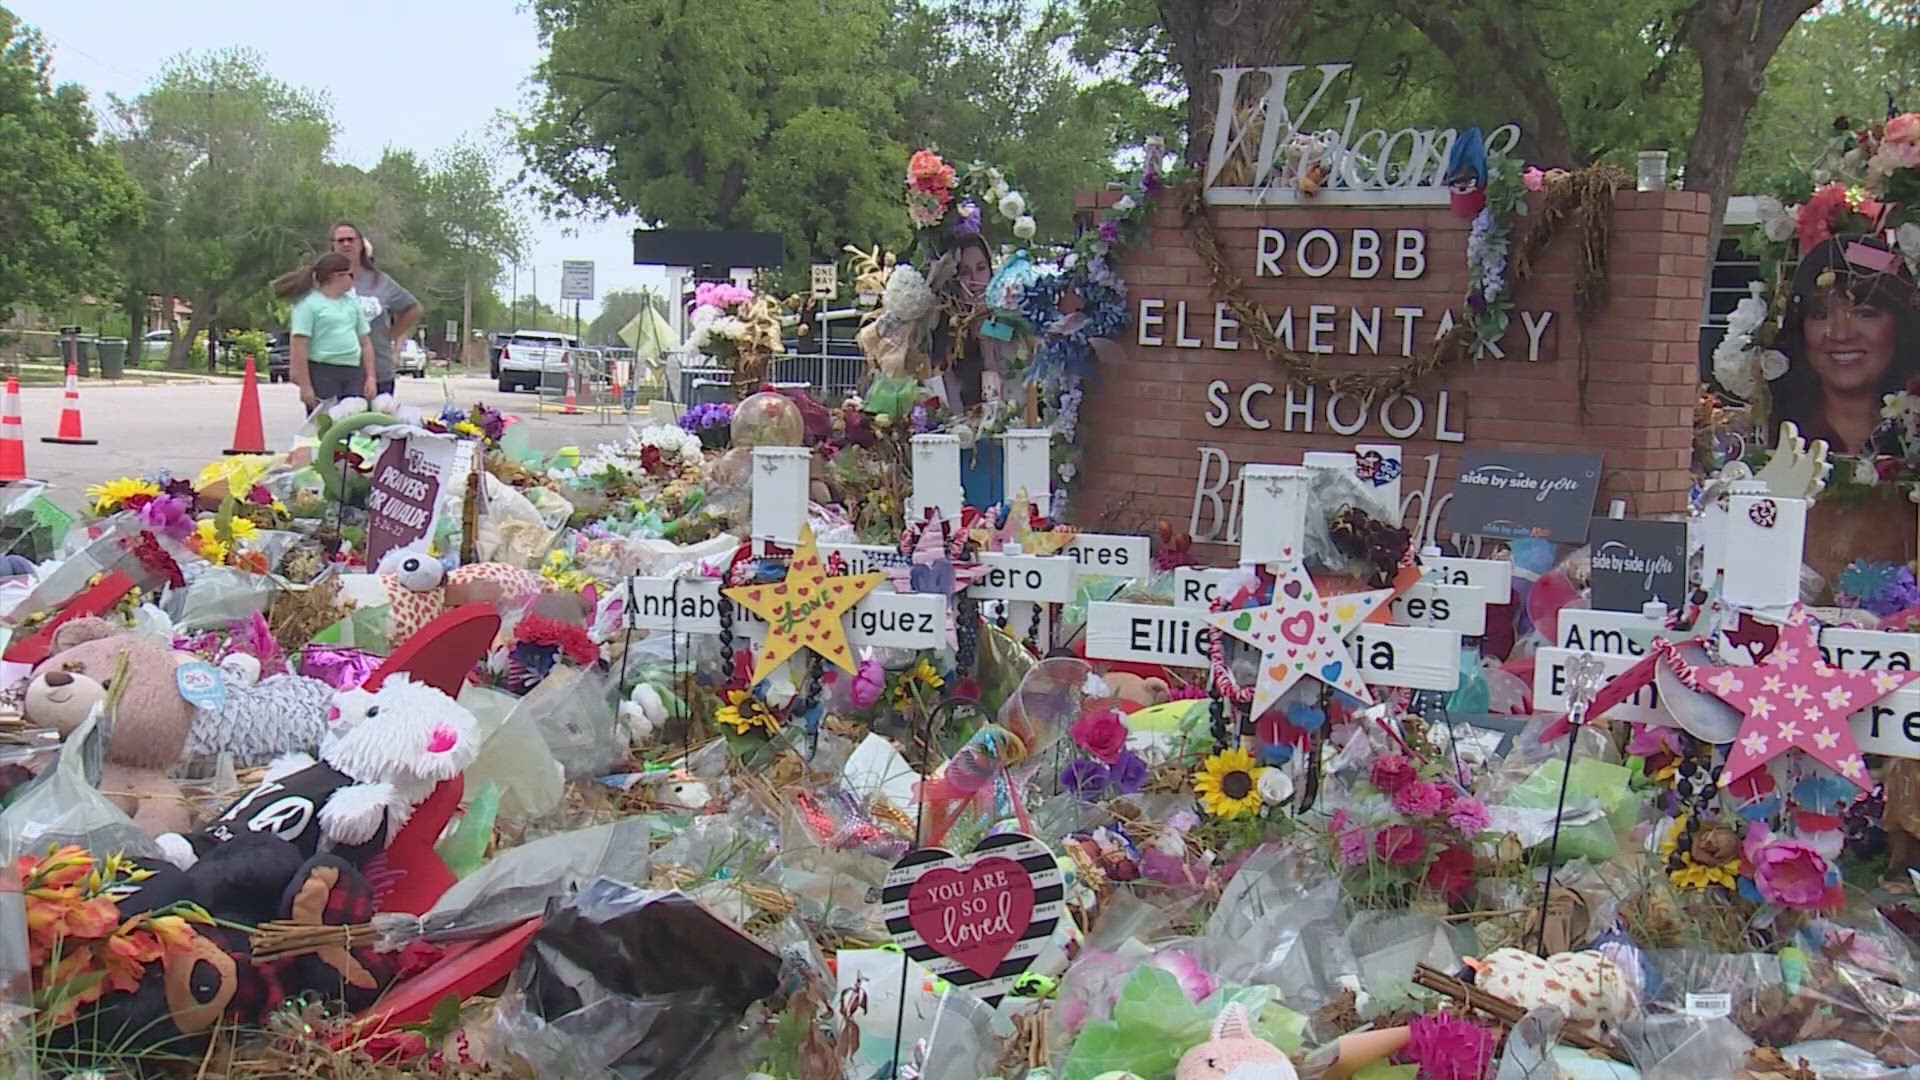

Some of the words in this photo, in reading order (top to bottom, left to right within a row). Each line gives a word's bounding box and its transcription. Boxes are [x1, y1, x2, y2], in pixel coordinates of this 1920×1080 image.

[1201, 62, 1521, 190] Wlcome
[1255, 228, 1427, 279] ROBB
[1204, 379, 1465, 442] SCHOOL
[379, 466, 429, 502] PRAYERS
[1461, 470, 1489, 485] side
[1490, 474, 1508, 488] by
[1509, 472, 1537, 489] side
[1536, 477, 1579, 501] you
[369, 487, 388, 512] OR
[382, 497, 430, 530] UVALDE
[374, 517, 405, 537] 5-24-22
[1592, 549, 1611, 570] side
[1611, 554, 1624, 574] by
[1624, 548, 1645, 573] side
[1644, 554, 1673, 591] you
[849, 604, 934, 636] iguez
[1355, 634, 1395, 671] ia
[1870, 705, 1920, 743] re
[928, 881, 965, 903] YOU
[972, 871, 1008, 893] ARE
[935, 891, 1015, 947] loved
[960, 897, 988, 917] SO
